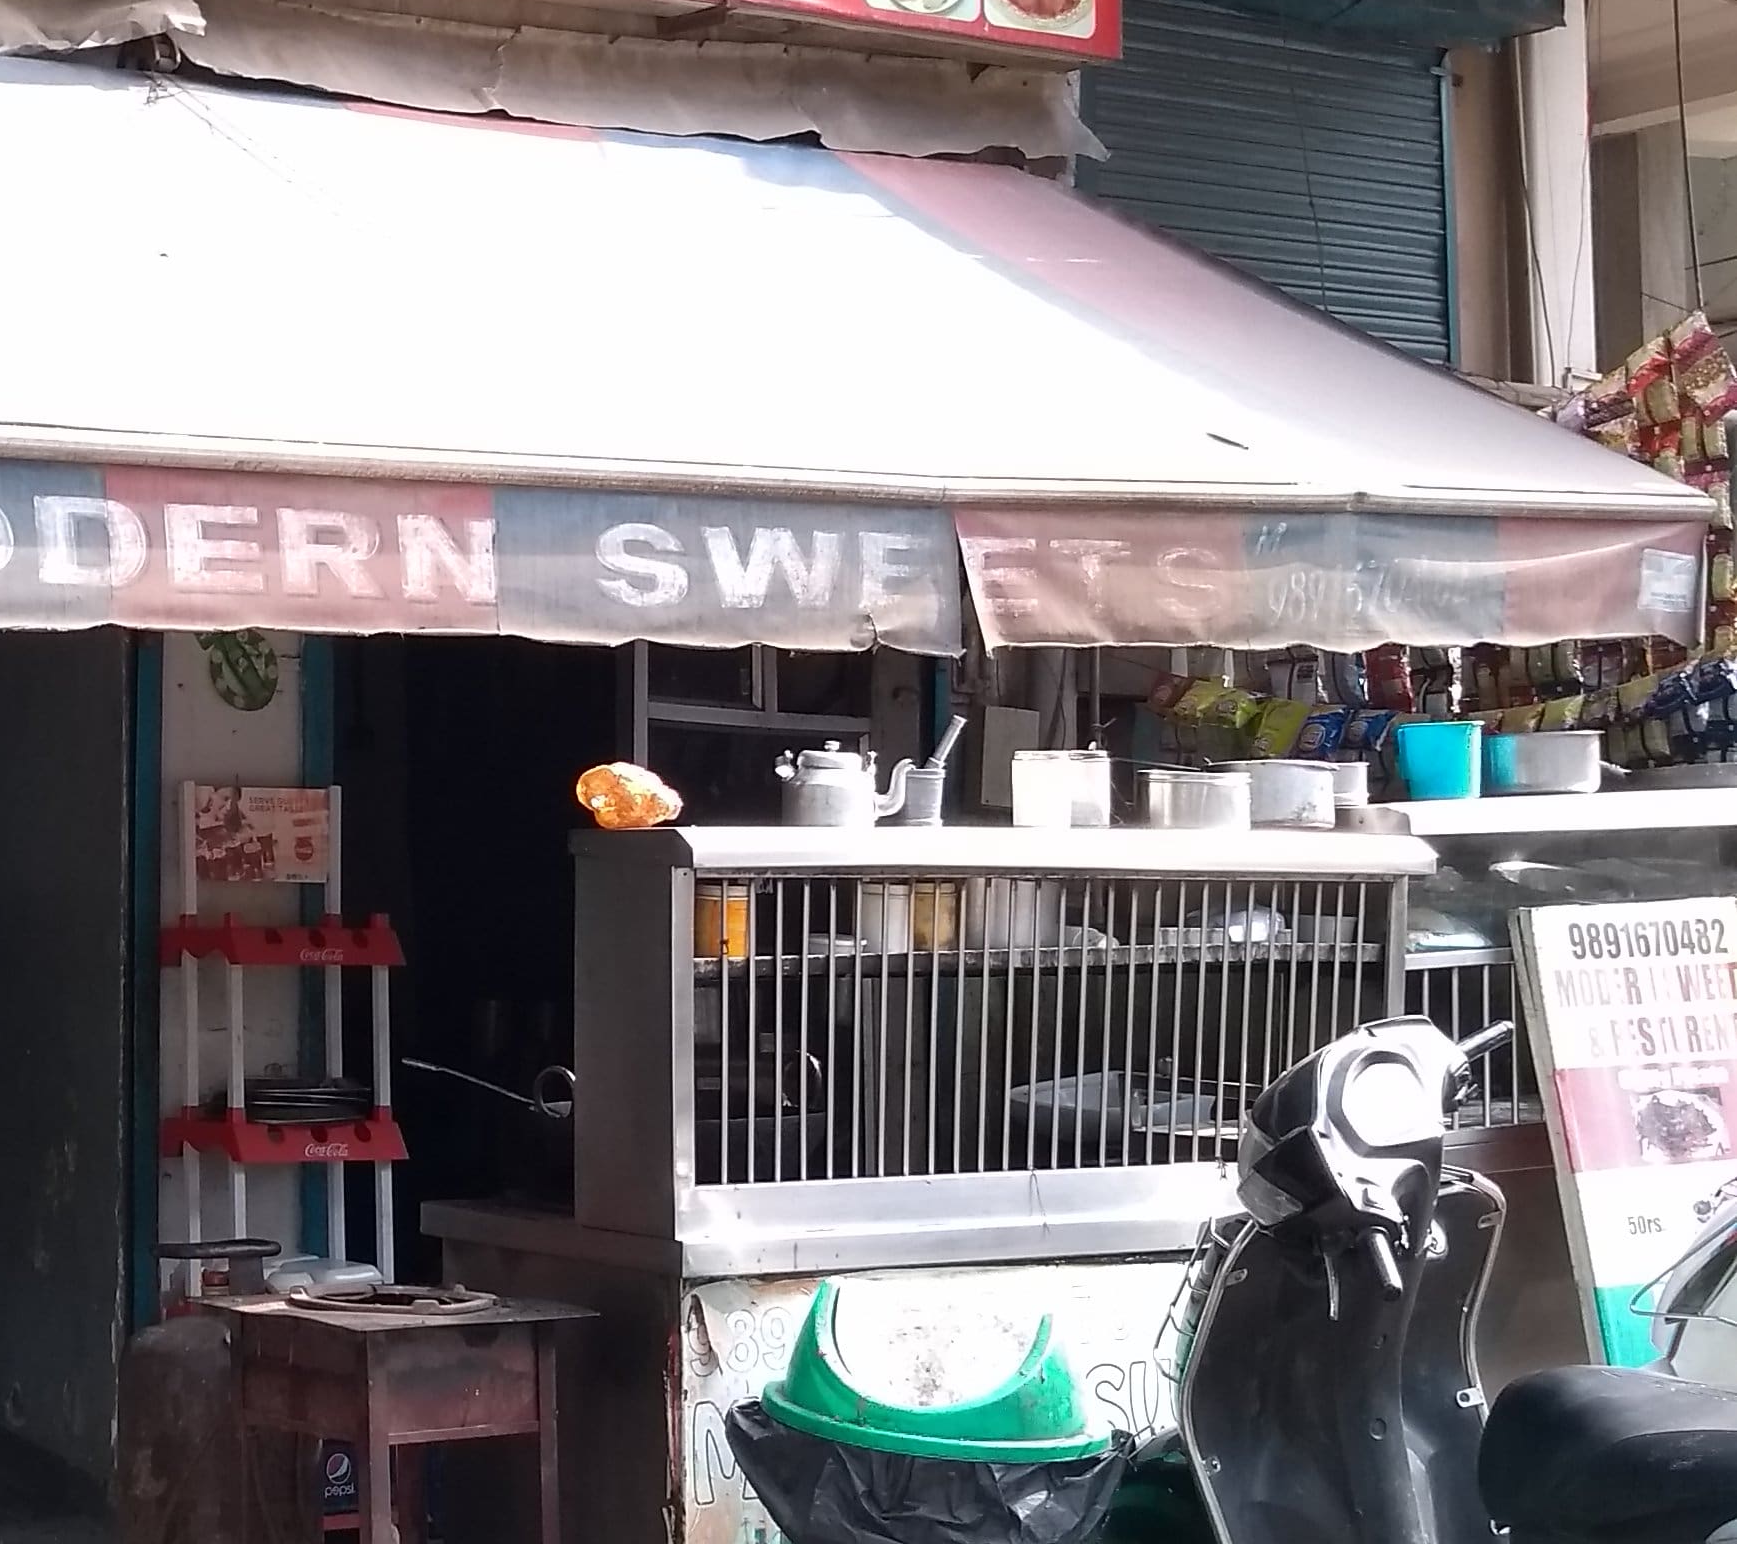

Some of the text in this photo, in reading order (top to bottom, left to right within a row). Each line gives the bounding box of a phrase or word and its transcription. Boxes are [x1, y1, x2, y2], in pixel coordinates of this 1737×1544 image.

[594, 522, 1231, 621] SWEETS
[1568, 919, 1730, 960] 9891670482
[324, 1482, 356, 1499] pepsi
